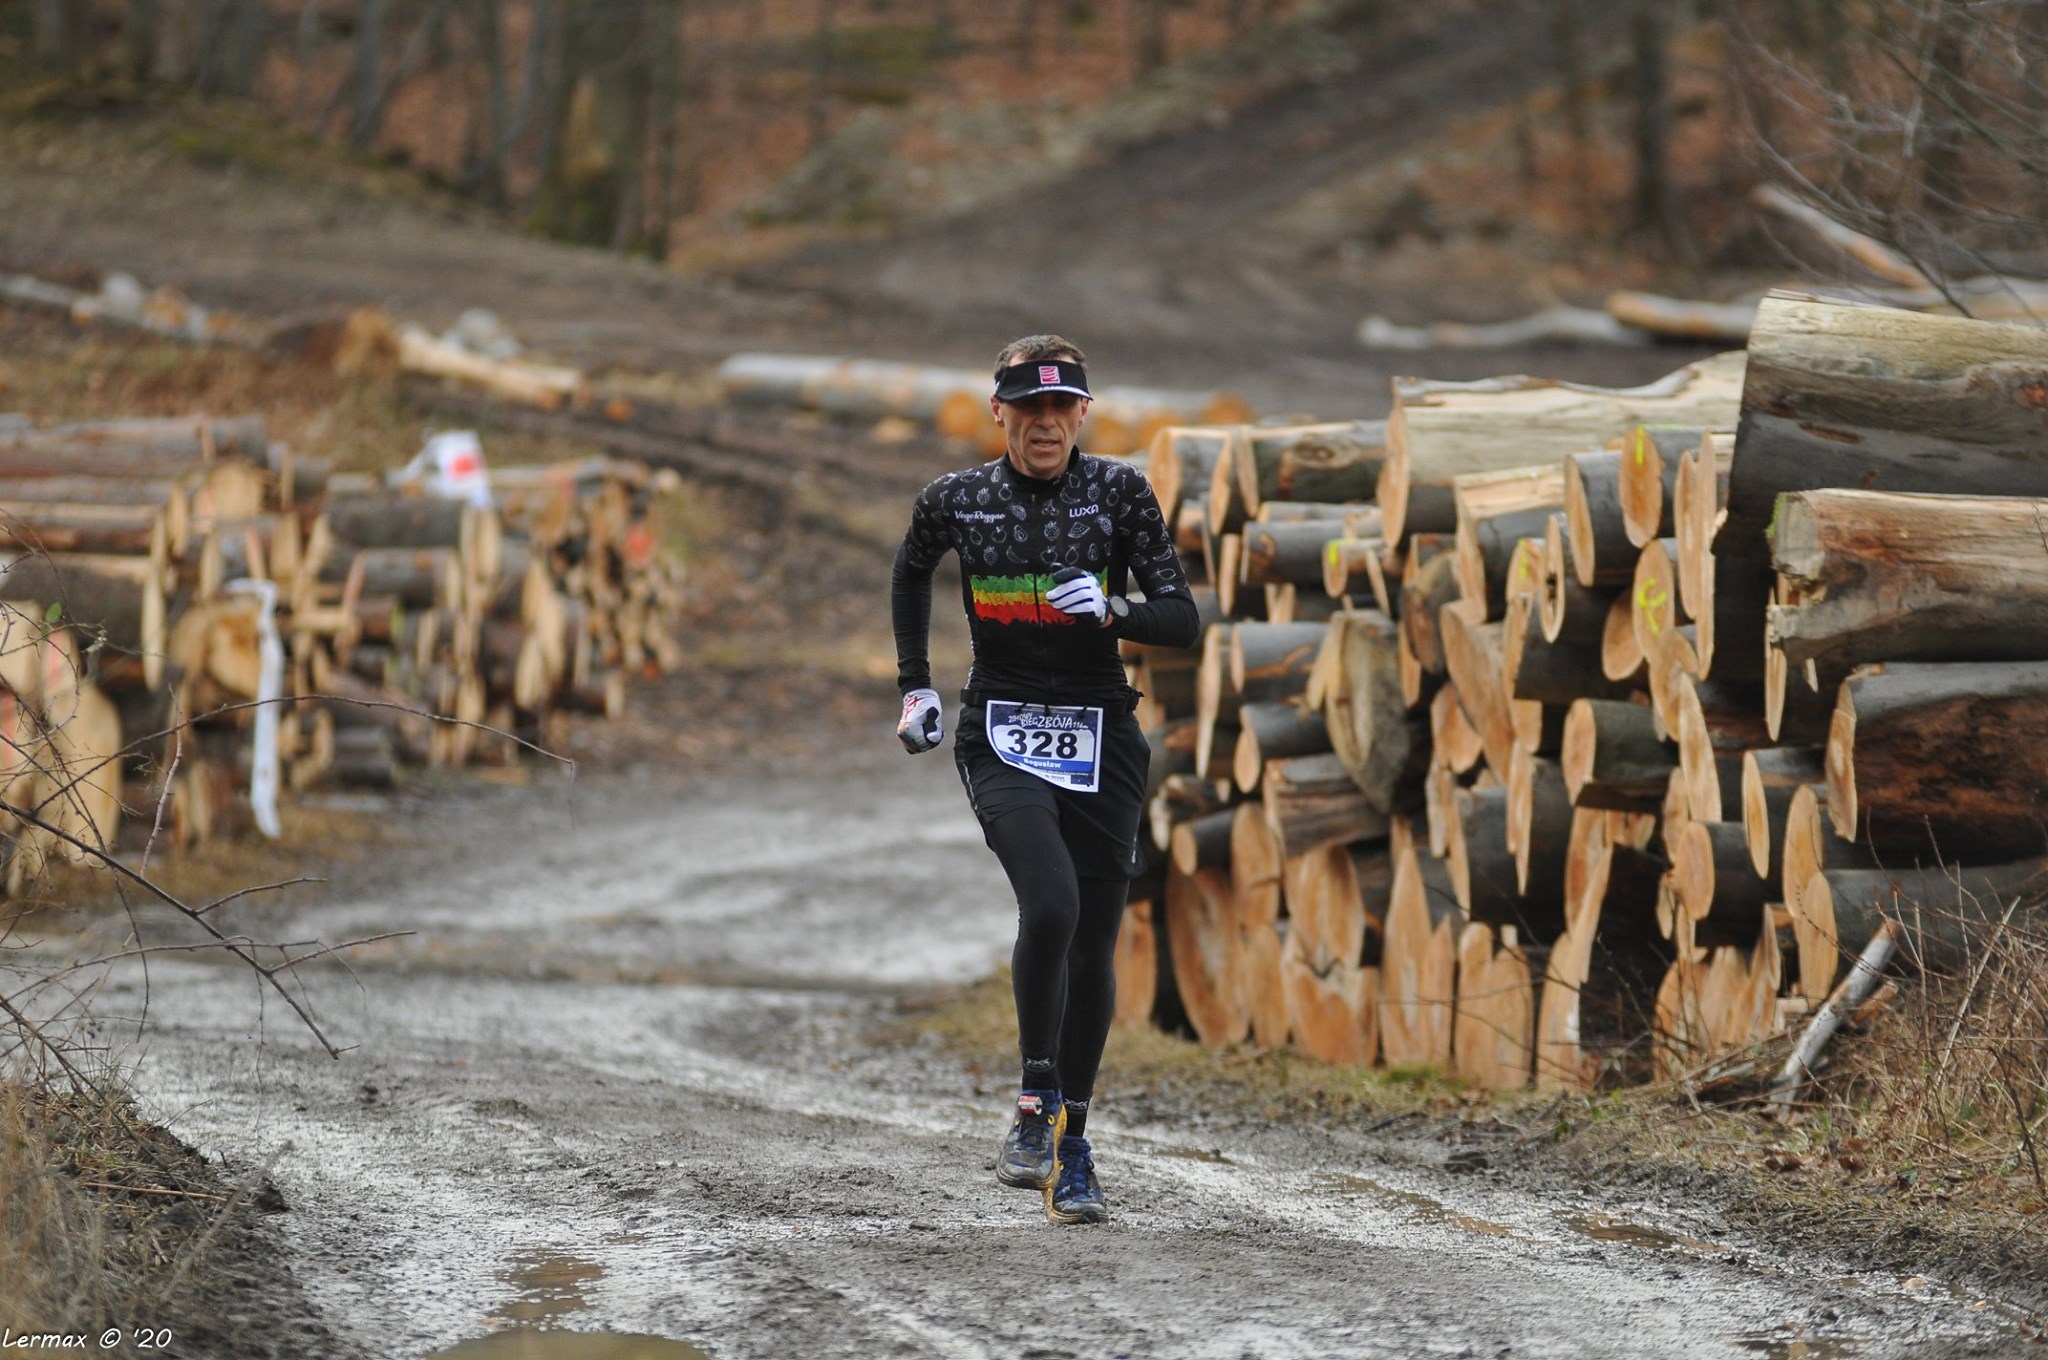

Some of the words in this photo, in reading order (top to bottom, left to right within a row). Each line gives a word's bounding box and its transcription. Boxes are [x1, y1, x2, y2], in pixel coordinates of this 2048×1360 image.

[1069, 504, 1099, 518] LUXA
[1037, 714, 1072, 729] ZBÓJA
[1007, 729, 1077, 759] 328
